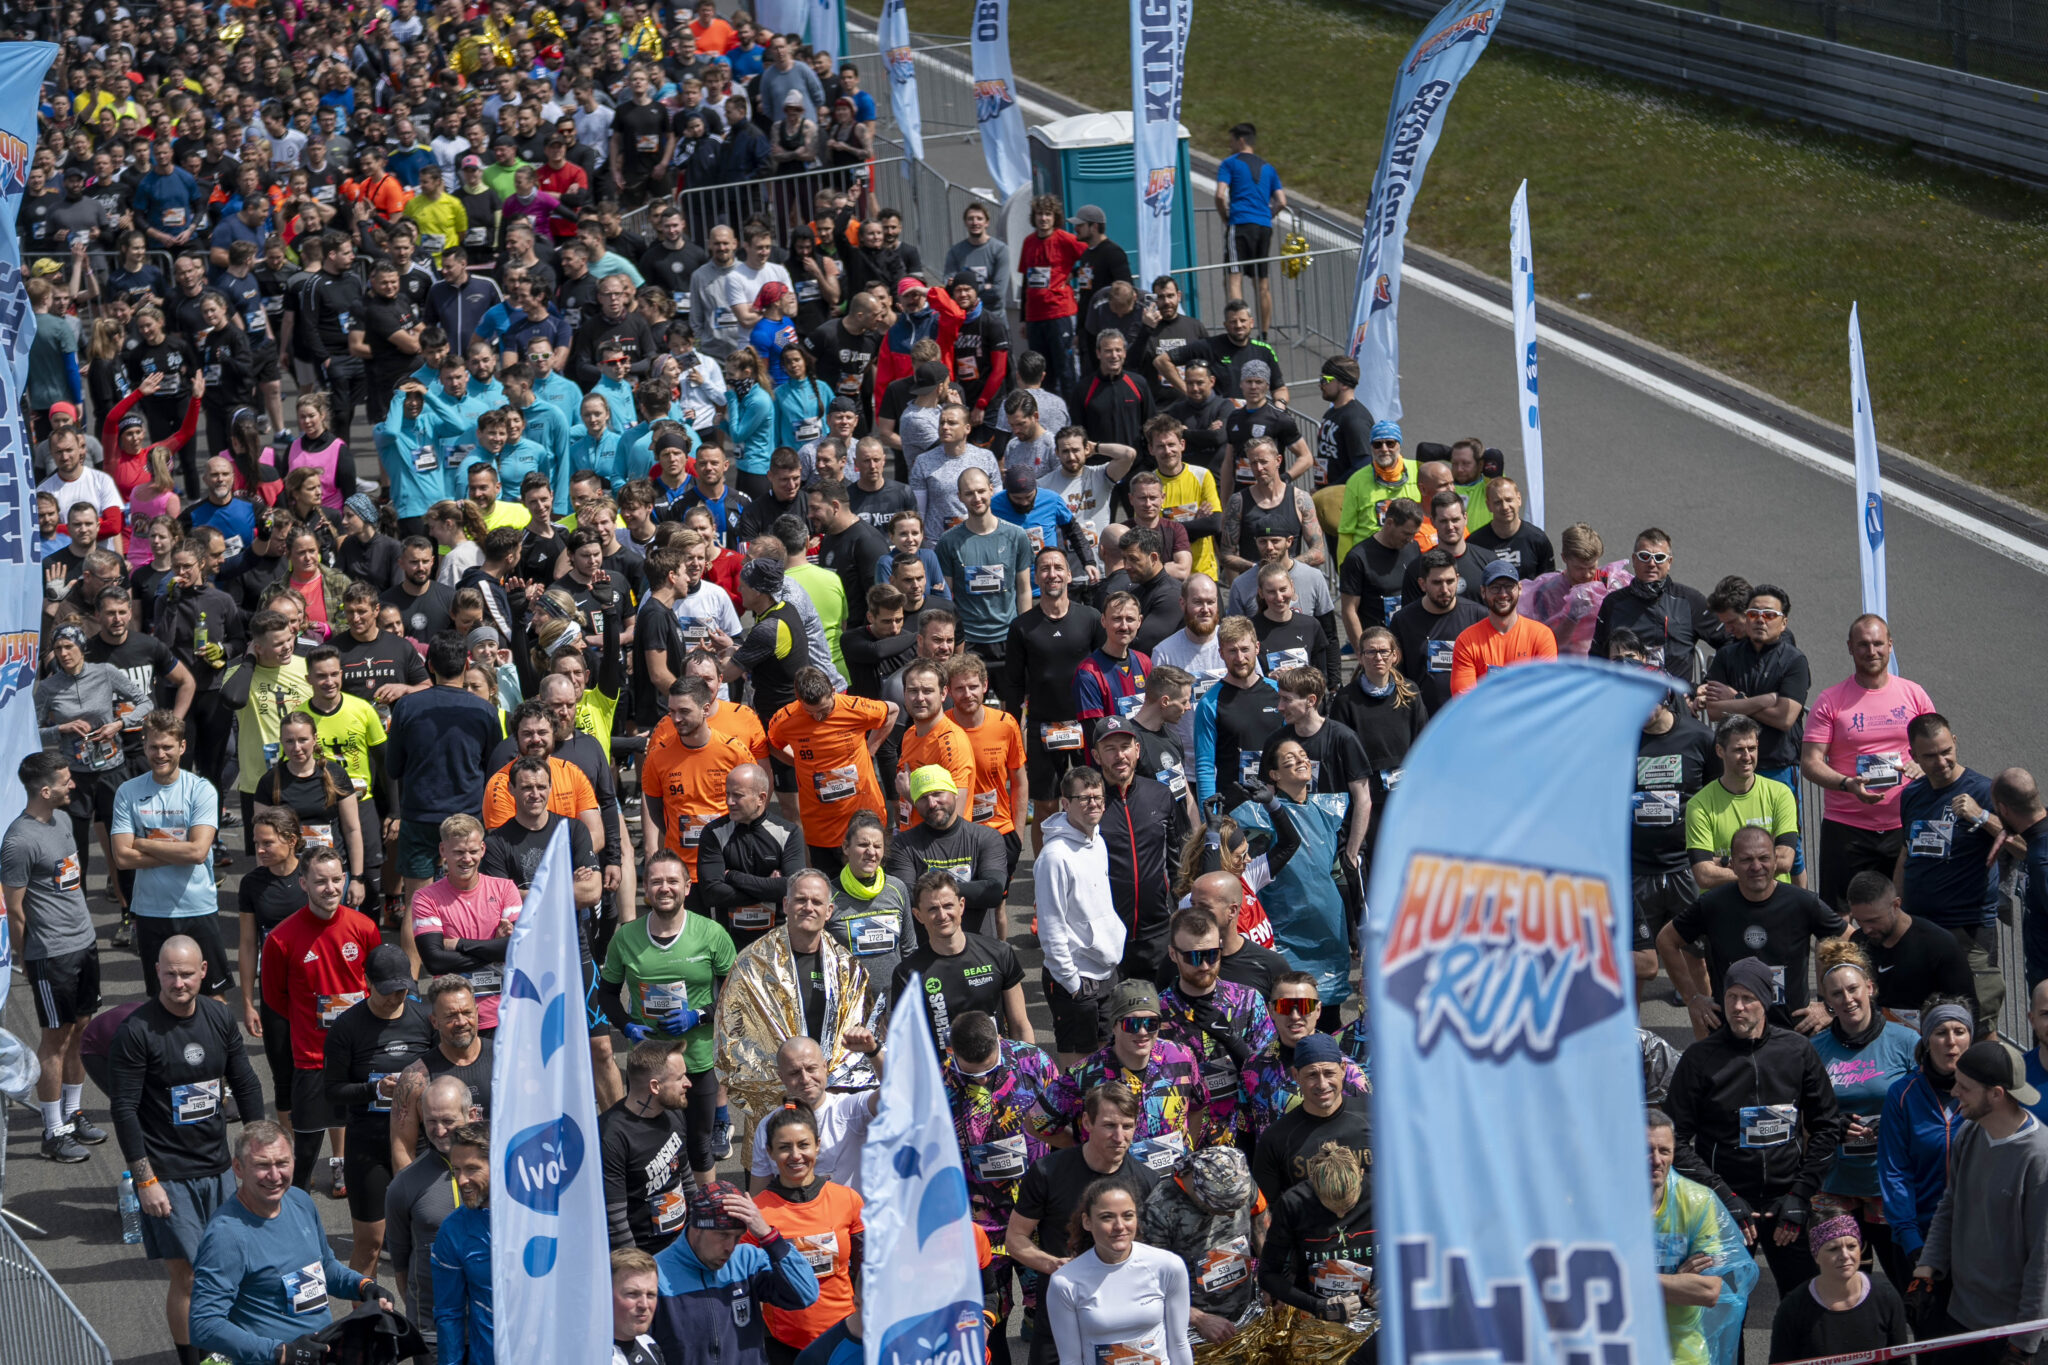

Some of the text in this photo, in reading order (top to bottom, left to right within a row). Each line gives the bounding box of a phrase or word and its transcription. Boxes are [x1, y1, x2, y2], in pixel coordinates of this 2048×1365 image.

[1141, 0, 1174, 124] KING
[344, 669, 396, 680] FINISHER
[258, 683, 268, 702] Gain
[798, 749, 814, 761] 99
[669, 783, 685, 796] 94
[1645, 807, 1662, 815] 3232
[1384, 856, 1626, 996] HOTFOOT
[868, 933, 884, 942] 1723
[963, 964, 992, 977] BEAST
[475, 976, 493, 985] 3925
[968, 975, 993, 987] Rakuten
[654, 998, 670, 1007] 1692
[1418, 943, 1579, 1050] RUN
[1209, 1078, 1228, 1089] 5941
[1759, 1125, 1779, 1134] 2800
[991, 1159, 1012, 1170] 5938
[1151, 1156, 1172, 1168] 5932
[645, 1164, 673, 1197] 2012
[1218, 1264, 1231, 1275] 539
[304, 1286, 320, 1299] 4807
